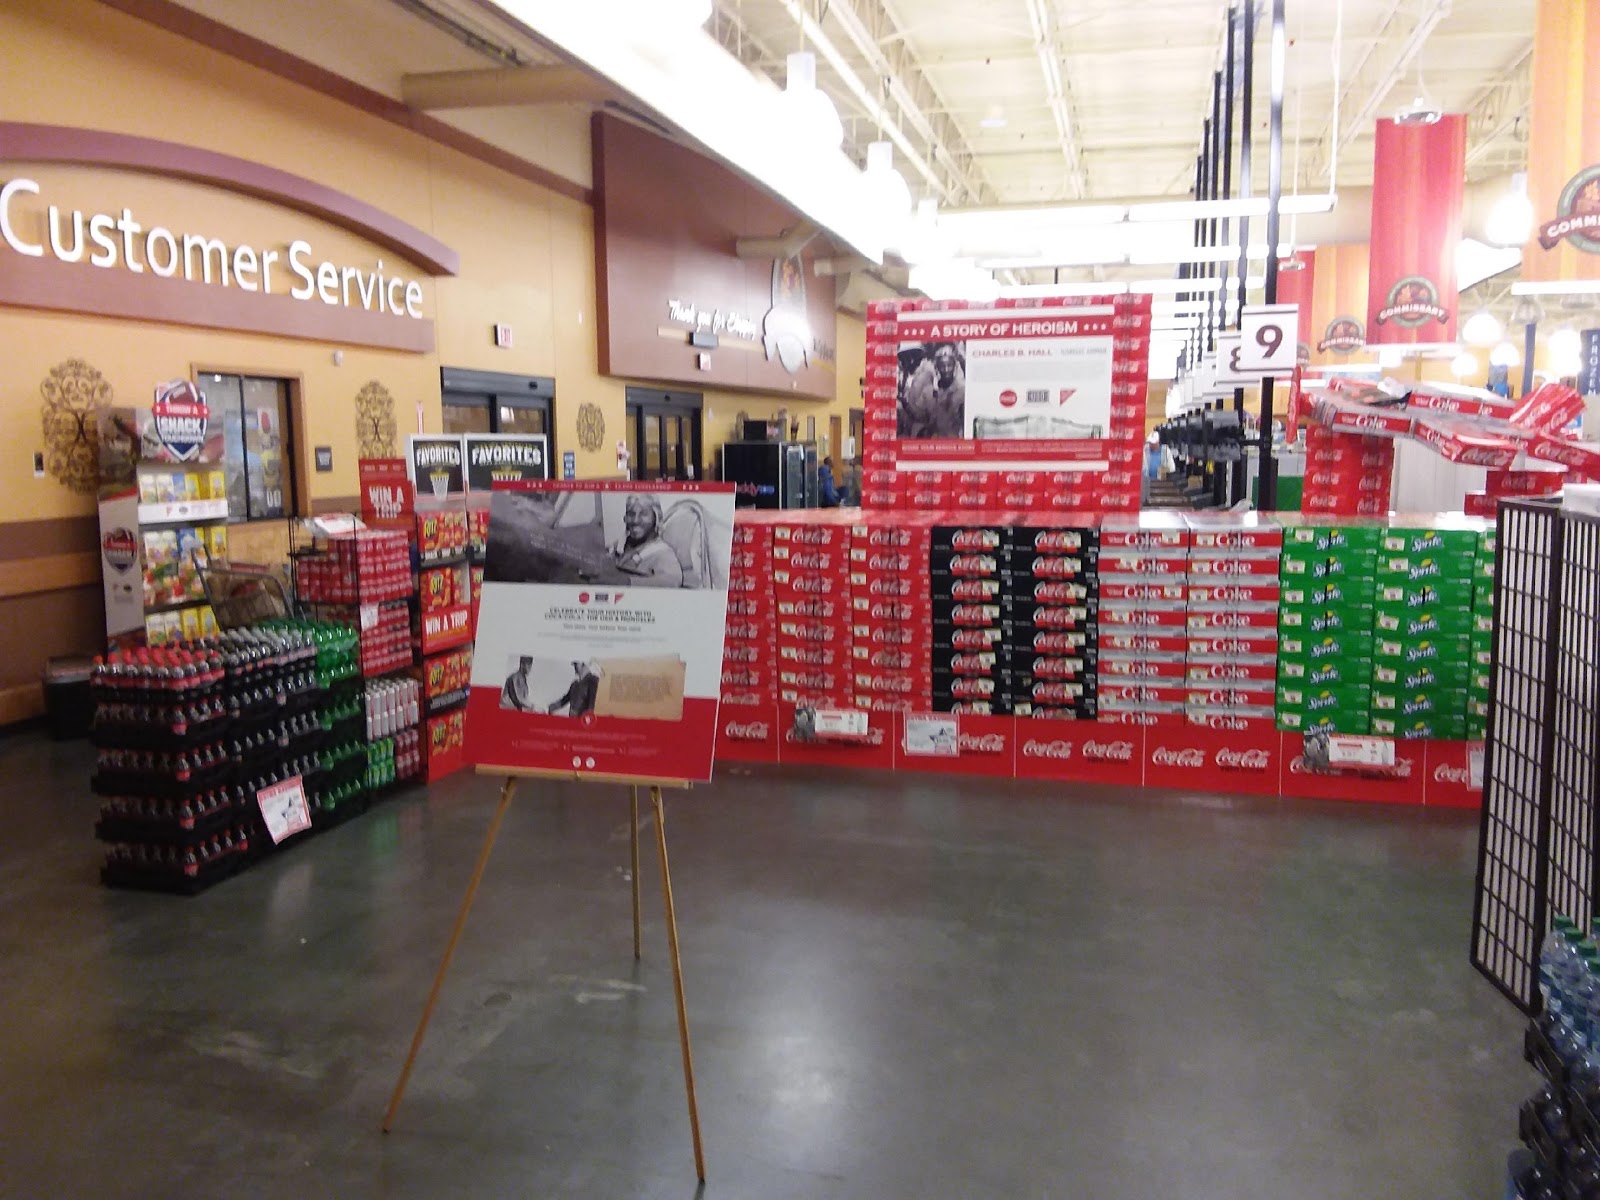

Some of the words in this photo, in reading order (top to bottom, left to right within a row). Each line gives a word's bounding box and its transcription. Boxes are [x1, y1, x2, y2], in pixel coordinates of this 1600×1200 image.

[0, 179, 279, 295] Customer
[287, 240, 423, 319] Service
[930, 325, 940, 338] A
[943, 323, 987, 337] STORY
[990, 322, 1010, 336] OF
[1012, 321, 1078, 336] HEROISM
[1256, 325, 1283, 359] 9
[1321, 336, 1365, 348] COMMISSAR
[1429, 397, 1460, 412] Coke
[1356, 414, 1387, 429] Coke
[369, 486, 393, 504] WIN
[396, 486, 404, 503] A
[1125, 532, 1161, 548] Coke
[1216, 532, 1255, 548] Coke
[1212, 560, 1251, 575] Coke
[1124, 584, 1161, 600] Coke
[1213, 586, 1252, 600] Coke
[425, 616, 440, 636] WIN
[443, 614, 449, 631] A
[450, 609, 468, 630] TRIP
[1212, 612, 1250, 626] Coke
[1212, 638, 1251, 653] Coke
[1211, 664, 1249, 678] Coke
[1210, 690, 1248, 704] Coke
[1210, 715, 1248, 730] Coke
